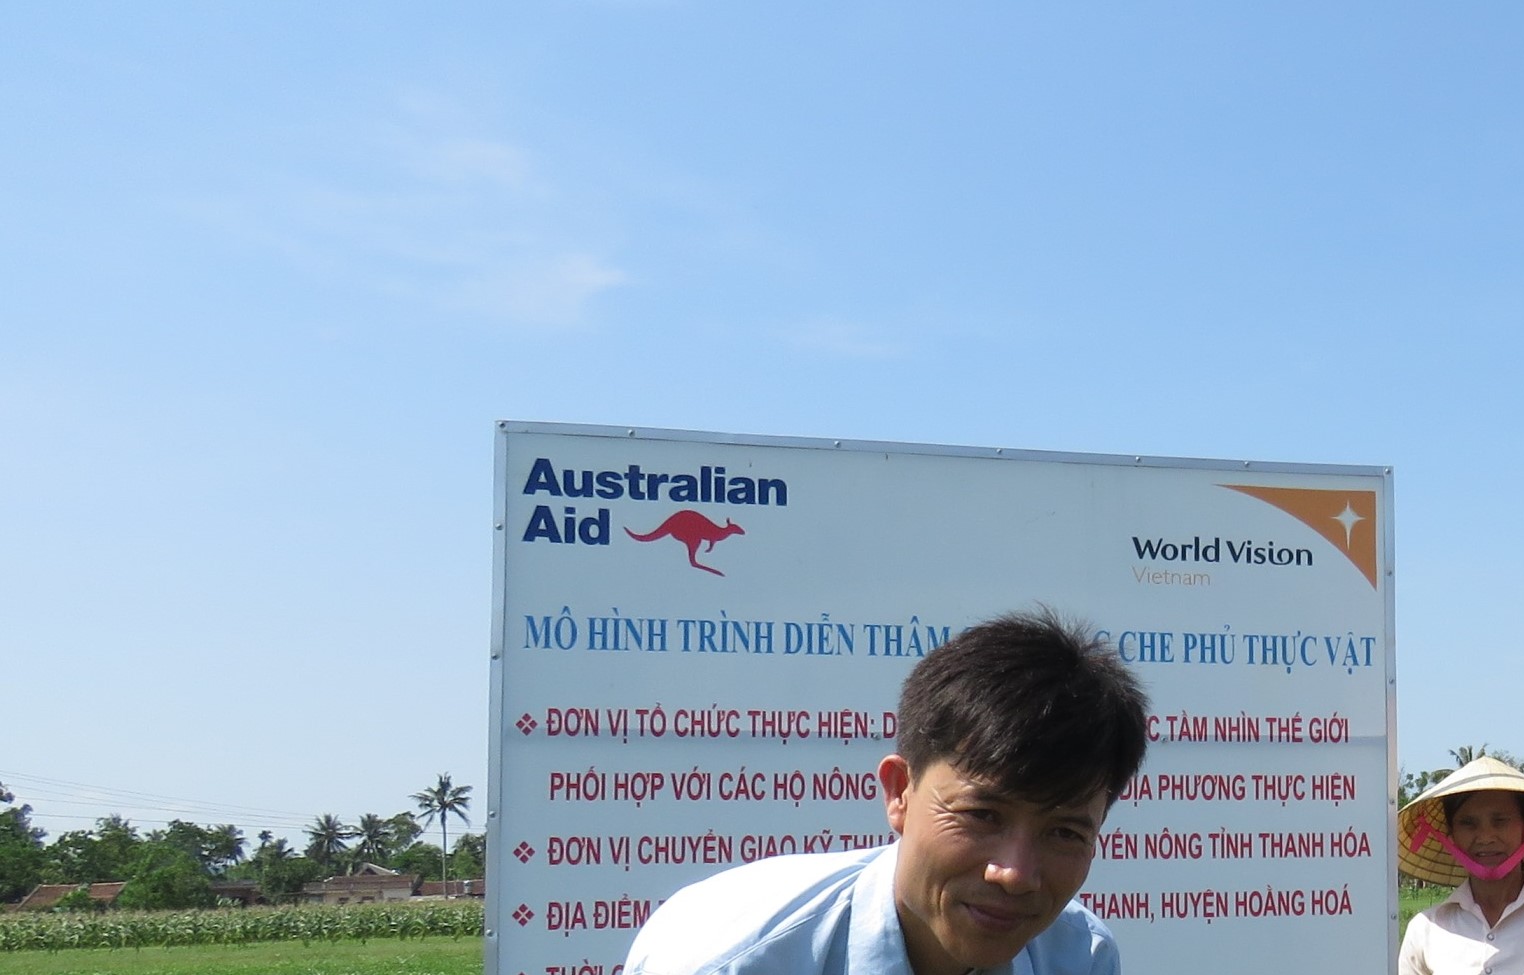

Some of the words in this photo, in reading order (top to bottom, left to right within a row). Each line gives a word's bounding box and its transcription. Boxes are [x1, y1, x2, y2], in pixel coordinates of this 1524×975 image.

[522, 457, 788, 506] Australian
[521, 504, 611, 546] Aid
[1132, 536, 1220, 563] World
[1226, 540, 1313, 567] Vision
[1131, 566, 1211, 586] Vietnam
[524, 605, 578, 651] MÔ
[586, 607, 669, 652] HÌNH
[677, 610, 775, 655] TRÌNH
[783, 612, 855, 656] DIỄN
[863, 615, 951, 657] THÂM
[1118, 631, 1175, 663] CHE
[1182, 624, 1235, 666] PHỦ
[1243, 631, 1318, 675] THỰC
[1324, 631, 1377, 676] VẬT
[546, 708, 600, 738] ĐƠN
[607, 709, 629, 744] VỊ
[635, 702, 667, 738] TỔ
[674, 703, 741, 738] CHỨC
[748, 710, 811, 745] THỰC
[818, 708, 875, 745] HIỆN:
[1214, 710, 1260, 743] NHÌN
[1265, 711, 1304, 743] THẾ
[1309, 711, 1349, 743] GIỚI
[550, 766, 606, 801] PHỐI
[614, 771, 665, 808] HỢP
[671, 766, 711, 801] VỚI
[718, 766, 766, 801] CÁC
[773, 770, 806, 808] HỘ
[812, 766, 877, 801] NÔNG
[1158, 774, 1246, 801] PHƯƠNG
[1251, 774, 1306, 807] THỰC
[1312, 772, 1356, 807] HIỆN
[547, 836, 601, 865] ĐƠN
[608, 836, 630, 871] VỊ
[637, 828, 732, 865] CHUYỂN
[740, 834, 797, 864] GIAO
[1145, 827, 1202, 860] NÔNG
[1208, 827, 1253, 859] TỈNH
[1258, 832, 1324, 859] THANH
[1330, 826, 1371, 858] HÓA
[546, 901, 587, 937] ĐỊA
[593, 893, 651, 930] ĐIỂM
[1161, 889, 1229, 924] HUYỆN
[1311, 883, 1353, 916] HOÁ
